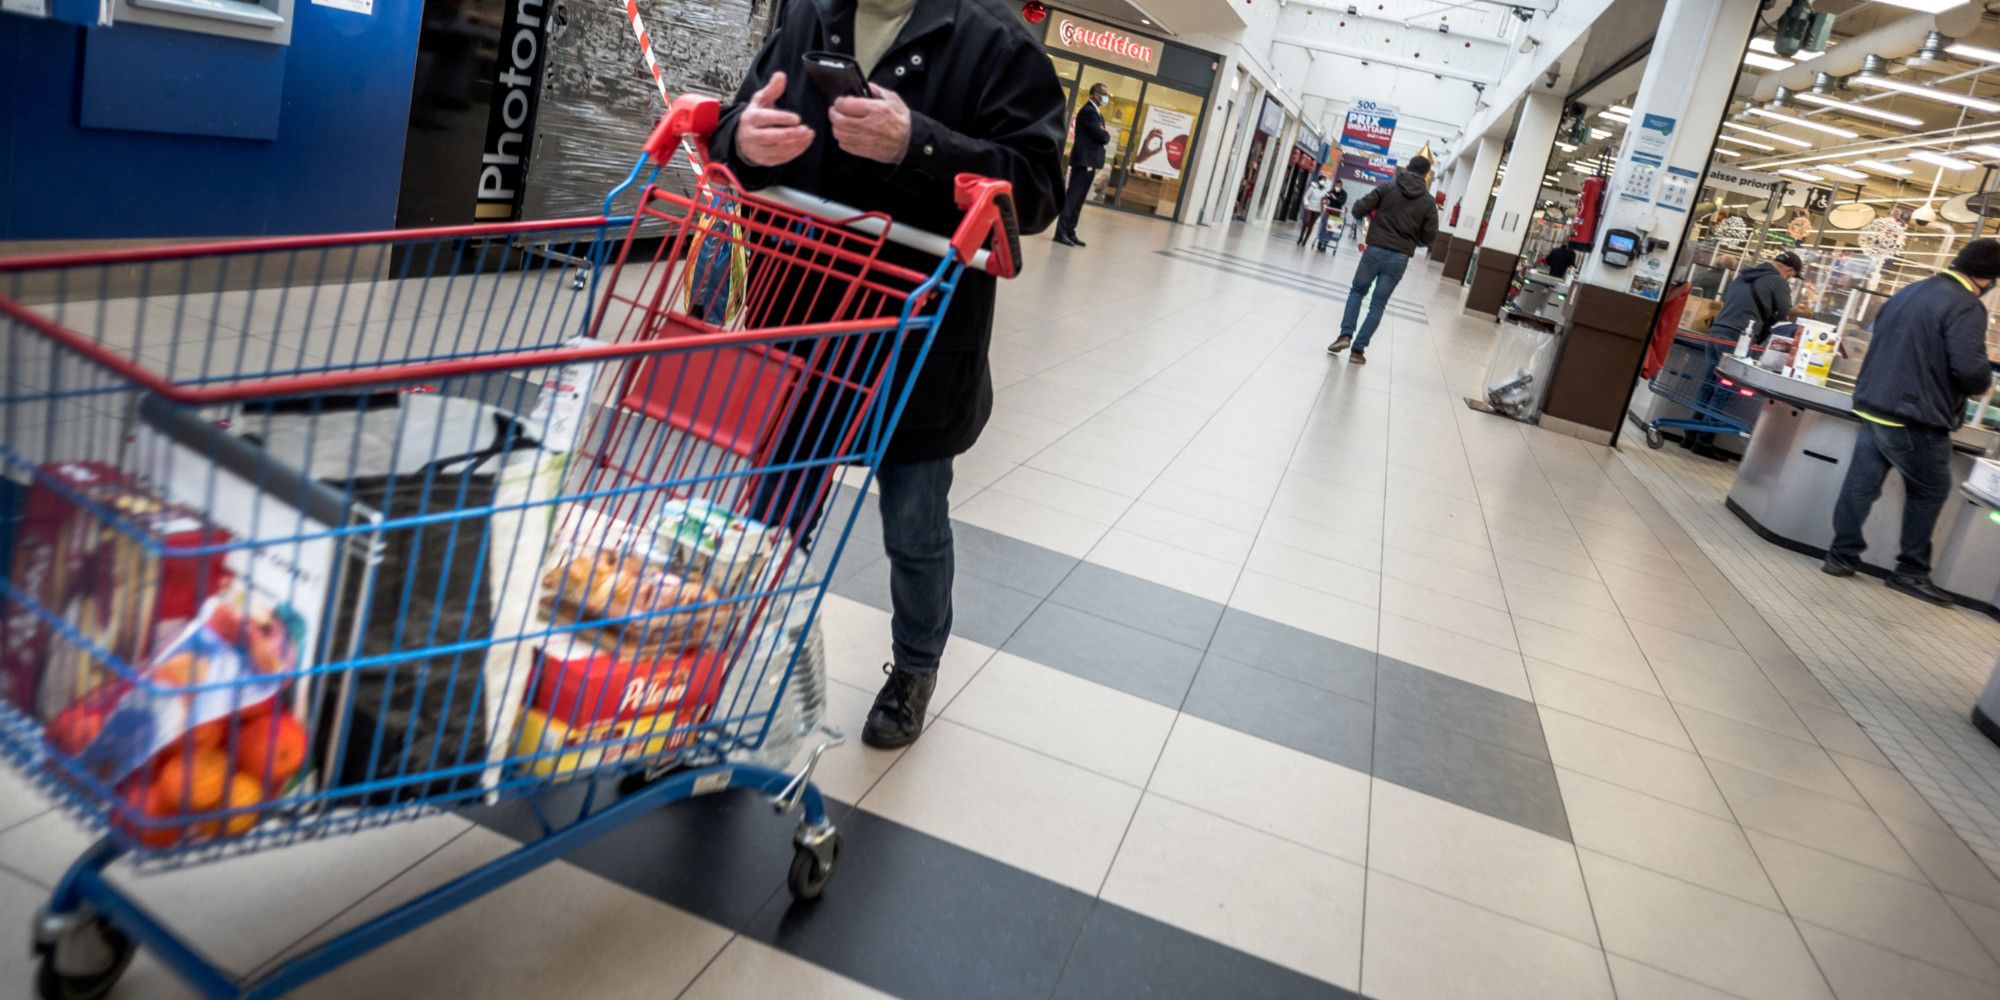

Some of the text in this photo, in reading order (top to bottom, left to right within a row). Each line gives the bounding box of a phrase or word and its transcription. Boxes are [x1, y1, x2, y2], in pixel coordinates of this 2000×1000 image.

[1357, 100, 1377, 110] 500
[1348, 112, 1381, 127] PRIX
[1708, 170, 1738, 184] aisse
